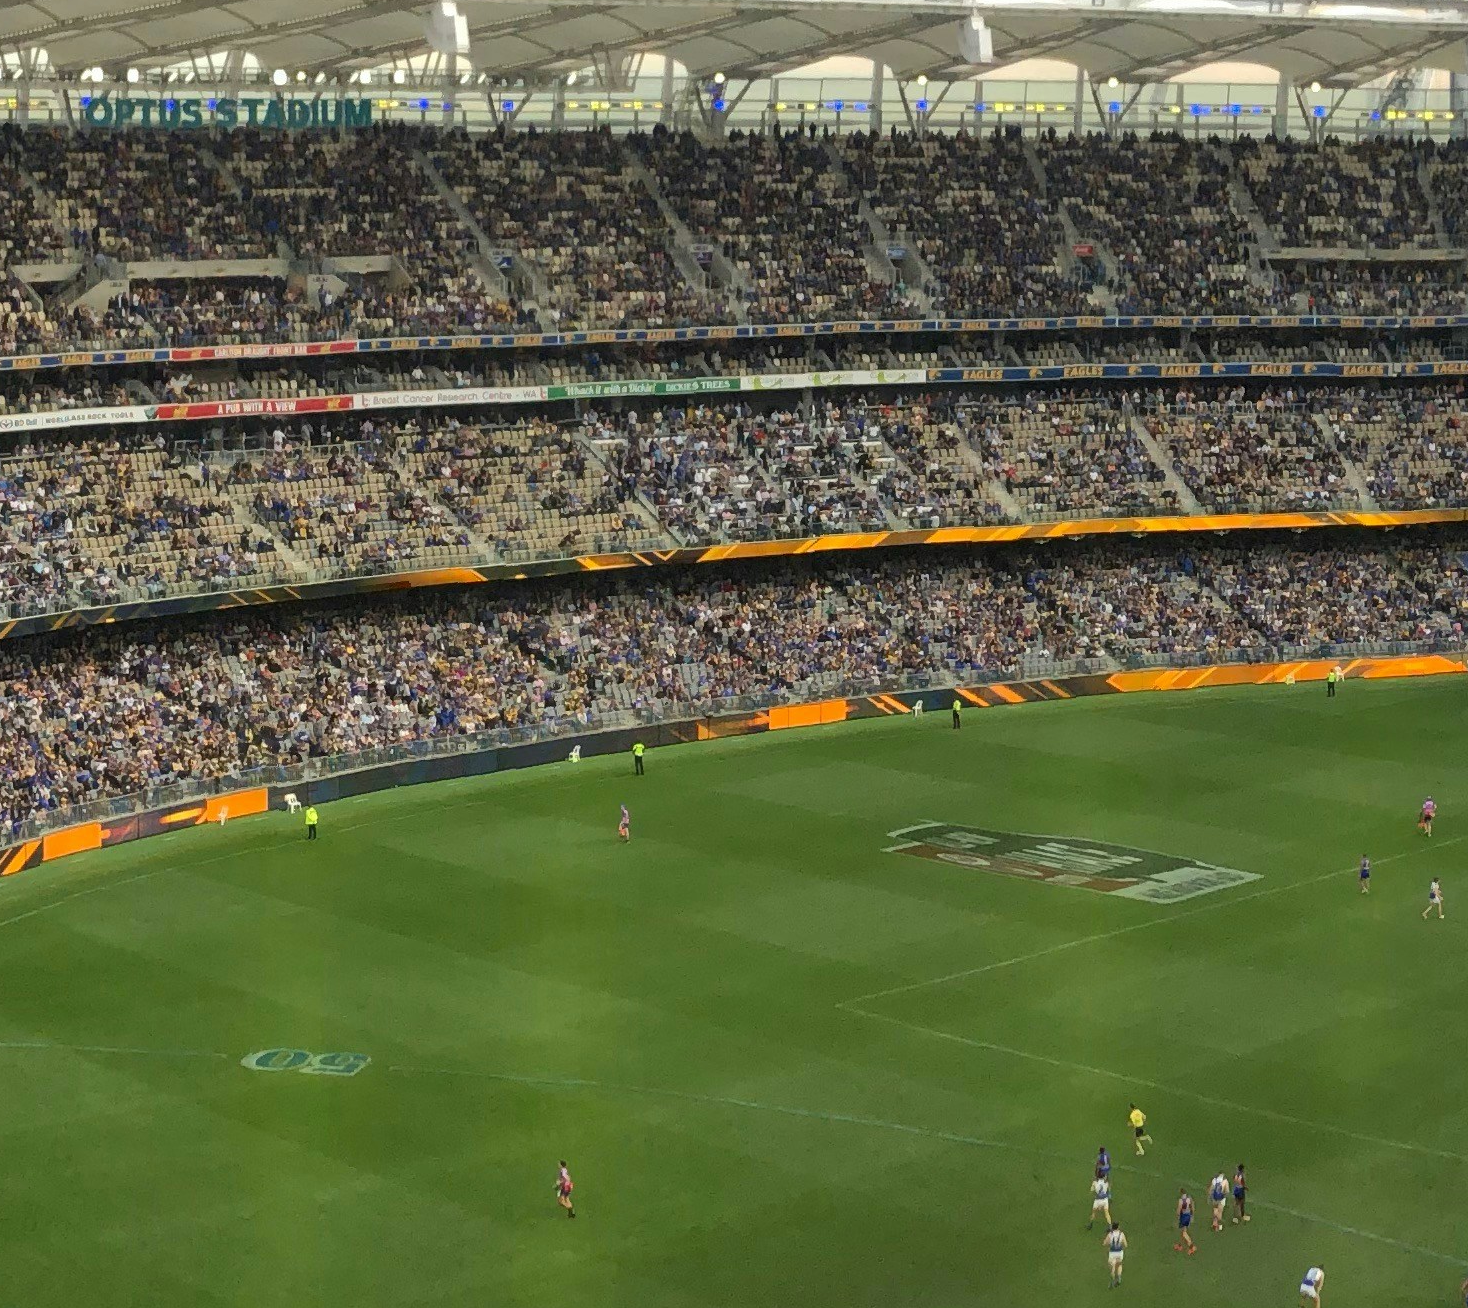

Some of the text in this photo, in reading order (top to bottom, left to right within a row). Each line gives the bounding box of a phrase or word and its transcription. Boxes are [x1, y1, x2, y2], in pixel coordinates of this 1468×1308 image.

[86, 98, 372, 128] OPTUS STADIUM
[701, 380, 730, 389] TREES
[373, 395, 399, 405] Breast
[403, 393, 434, 403] Cancer
[437, 391, 476, 402] Research
[482, 391, 512, 400] Centre
[524, 390, 536, 398] WA
[226, 403, 240, 413] PUB
[243, 402, 263, 413] WITH
[275, 401, 296, 411] VIEW
